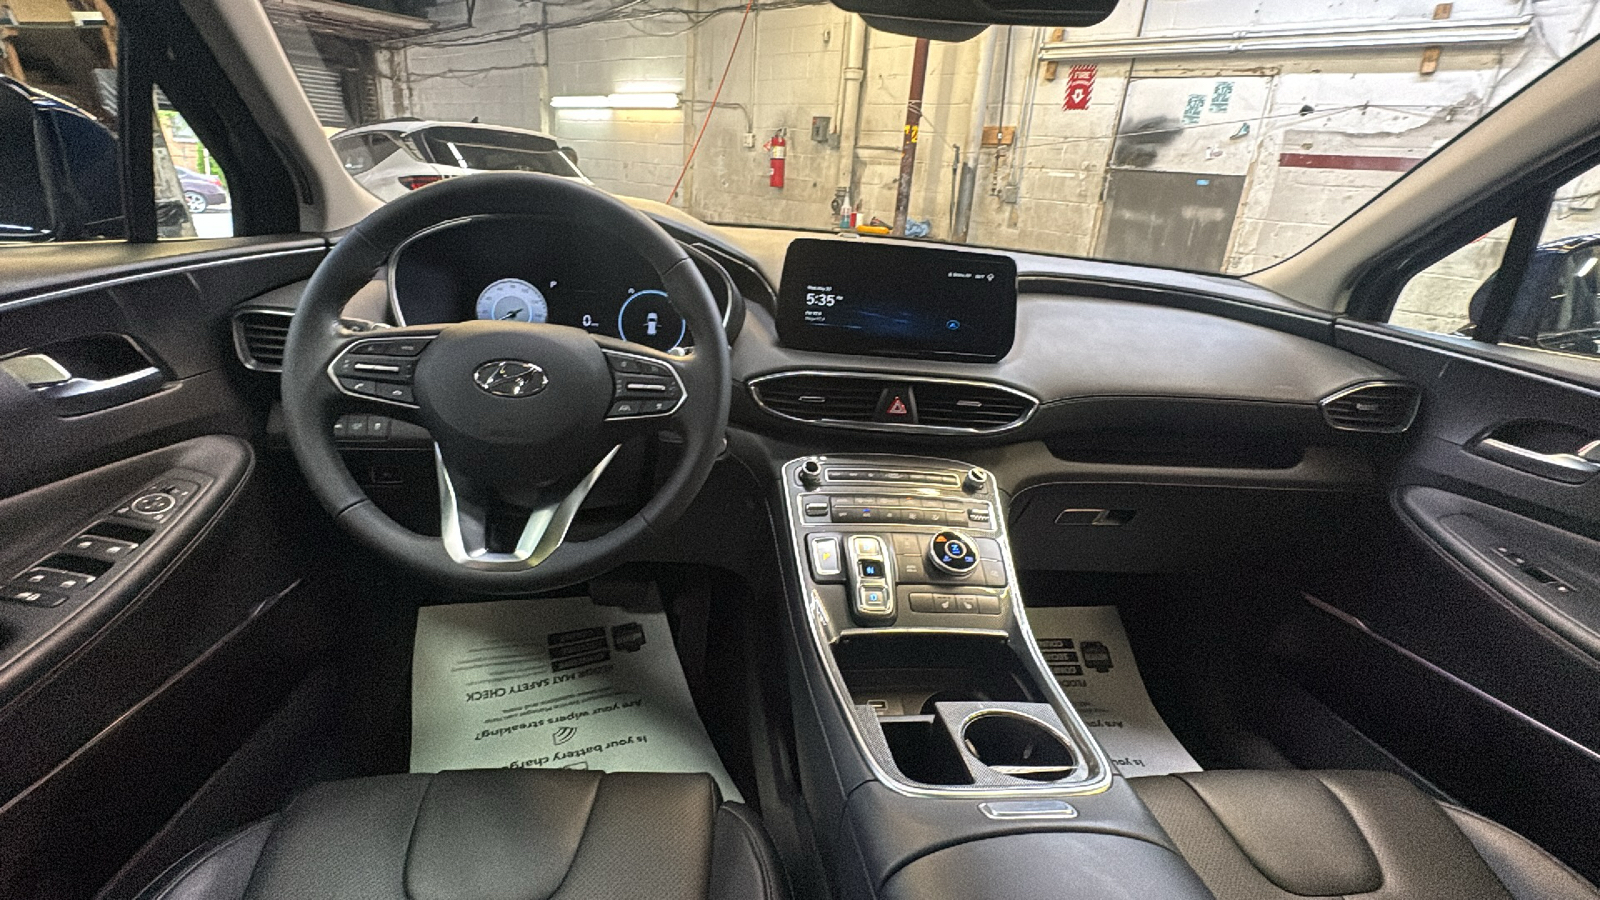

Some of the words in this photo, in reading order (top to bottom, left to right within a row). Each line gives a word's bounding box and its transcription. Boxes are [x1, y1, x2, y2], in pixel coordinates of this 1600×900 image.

[806, 293, 836, 306] 5:35
[582, 314, 591, 326] 0
[551, 671, 576, 684] MAT
[1059, 679, 1087, 688] FLOO
[508, 677, 550, 694] SAFETY
[466, 687, 507, 702] CHECK
[592, 703, 620, 715] your
[622, 699, 642, 708] Are
[547, 712, 590, 724] wipers
[475, 719, 545, 741] streaking?
[605, 736, 635, 750] your
[636, 735, 648, 744] Is
[552, 744, 603, 761] battery
[501, 756, 549, 770] charg
[1111, 757, 1132, 767] you
[1133, 759, 1145, 768] Is
